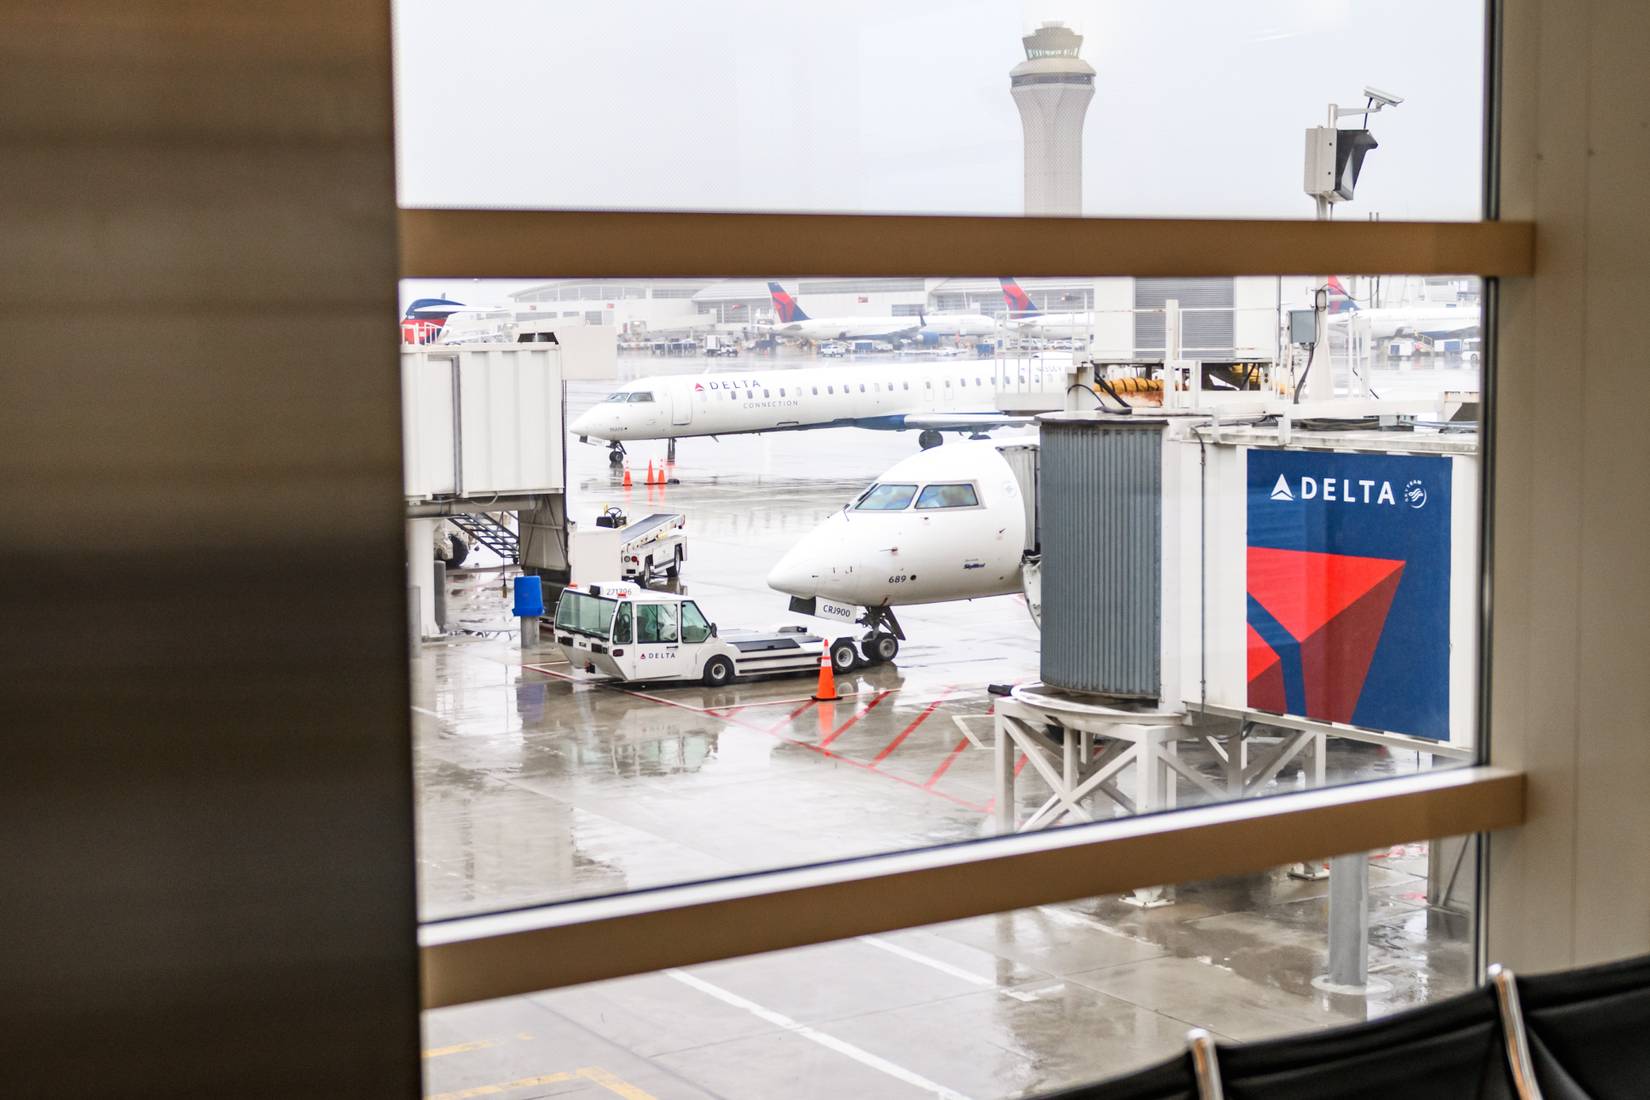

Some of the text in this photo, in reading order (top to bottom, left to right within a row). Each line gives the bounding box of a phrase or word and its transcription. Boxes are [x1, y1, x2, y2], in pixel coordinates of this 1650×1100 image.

[709, 380, 761, 390] DELTA
[743, 400, 798, 409] CONNECTION
[1301, 476, 1396, 505] DELTA
[888, 575, 907, 583] 689
[823, 604, 851, 618] CRJ900
